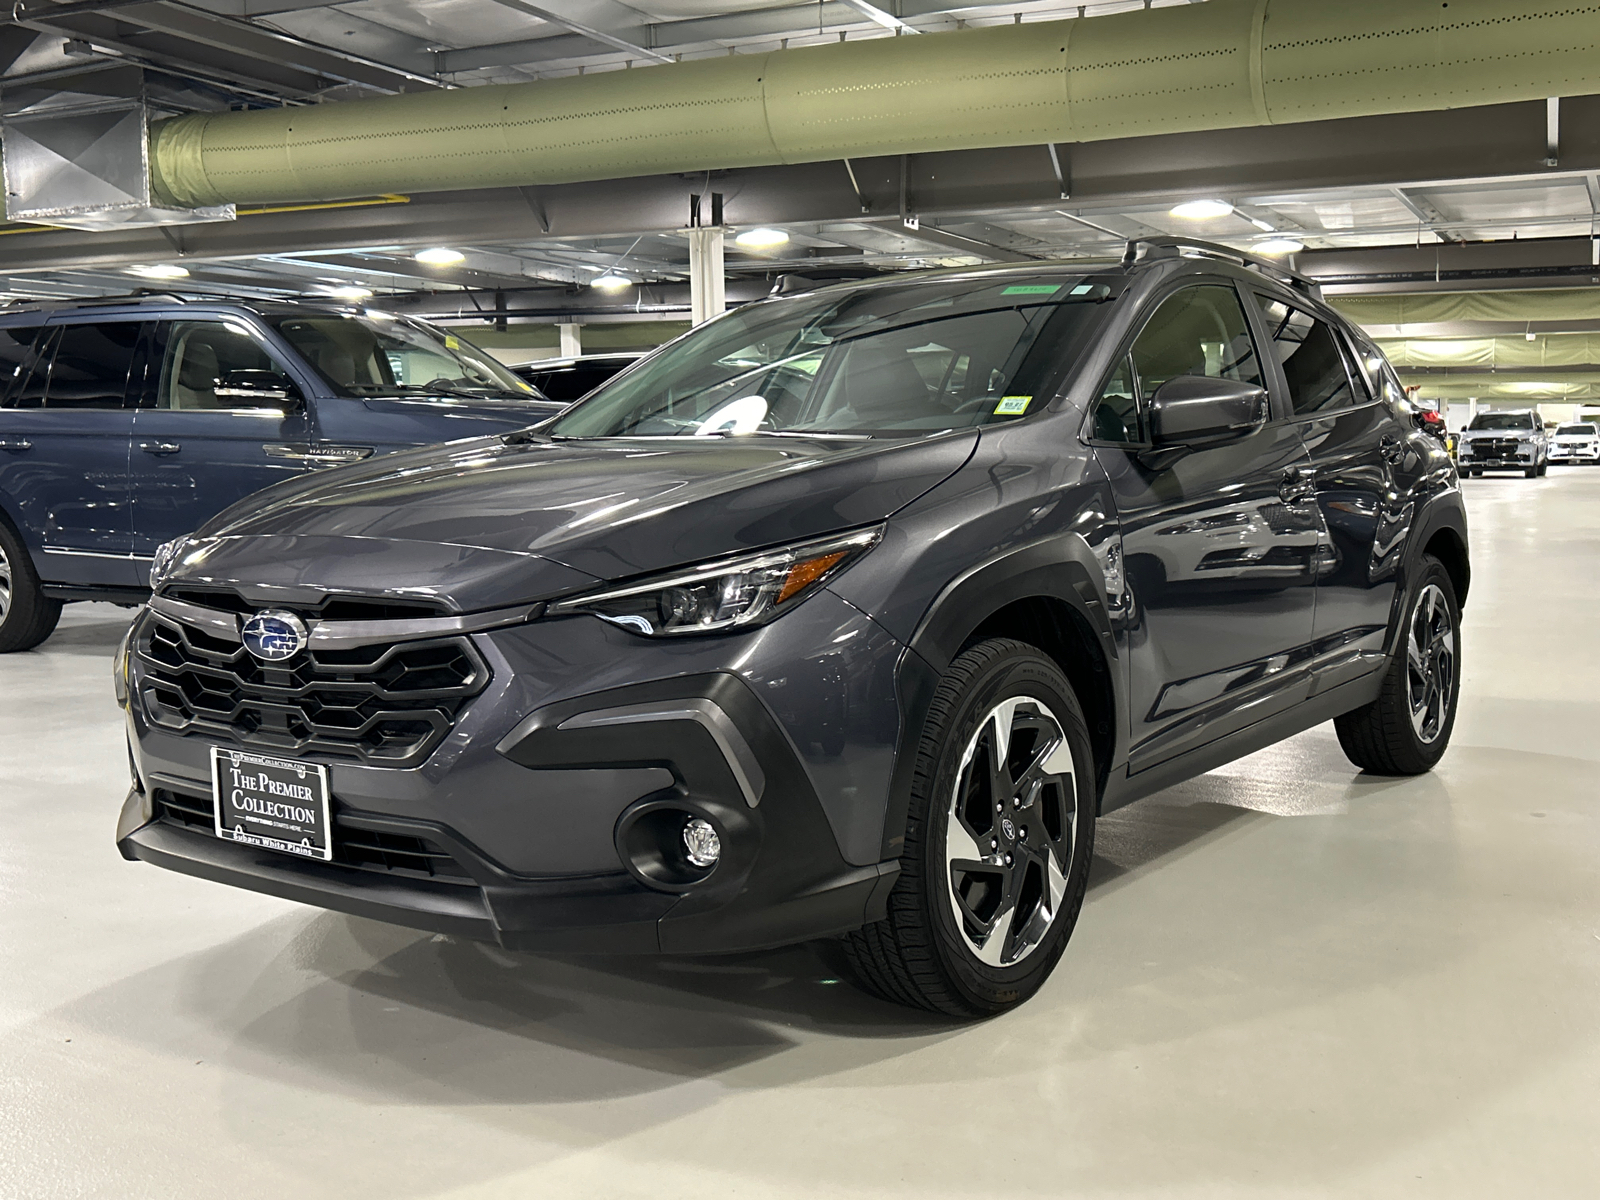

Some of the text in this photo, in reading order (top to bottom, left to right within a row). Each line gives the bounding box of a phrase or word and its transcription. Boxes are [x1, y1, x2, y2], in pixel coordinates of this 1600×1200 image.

[309, 448, 359, 456] NAVIGATOR
[230, 767, 314, 802] THE PREMIER
[231, 789, 316, 825] COLLECTION
[233, 832, 313, 856] Subaru White Plains
